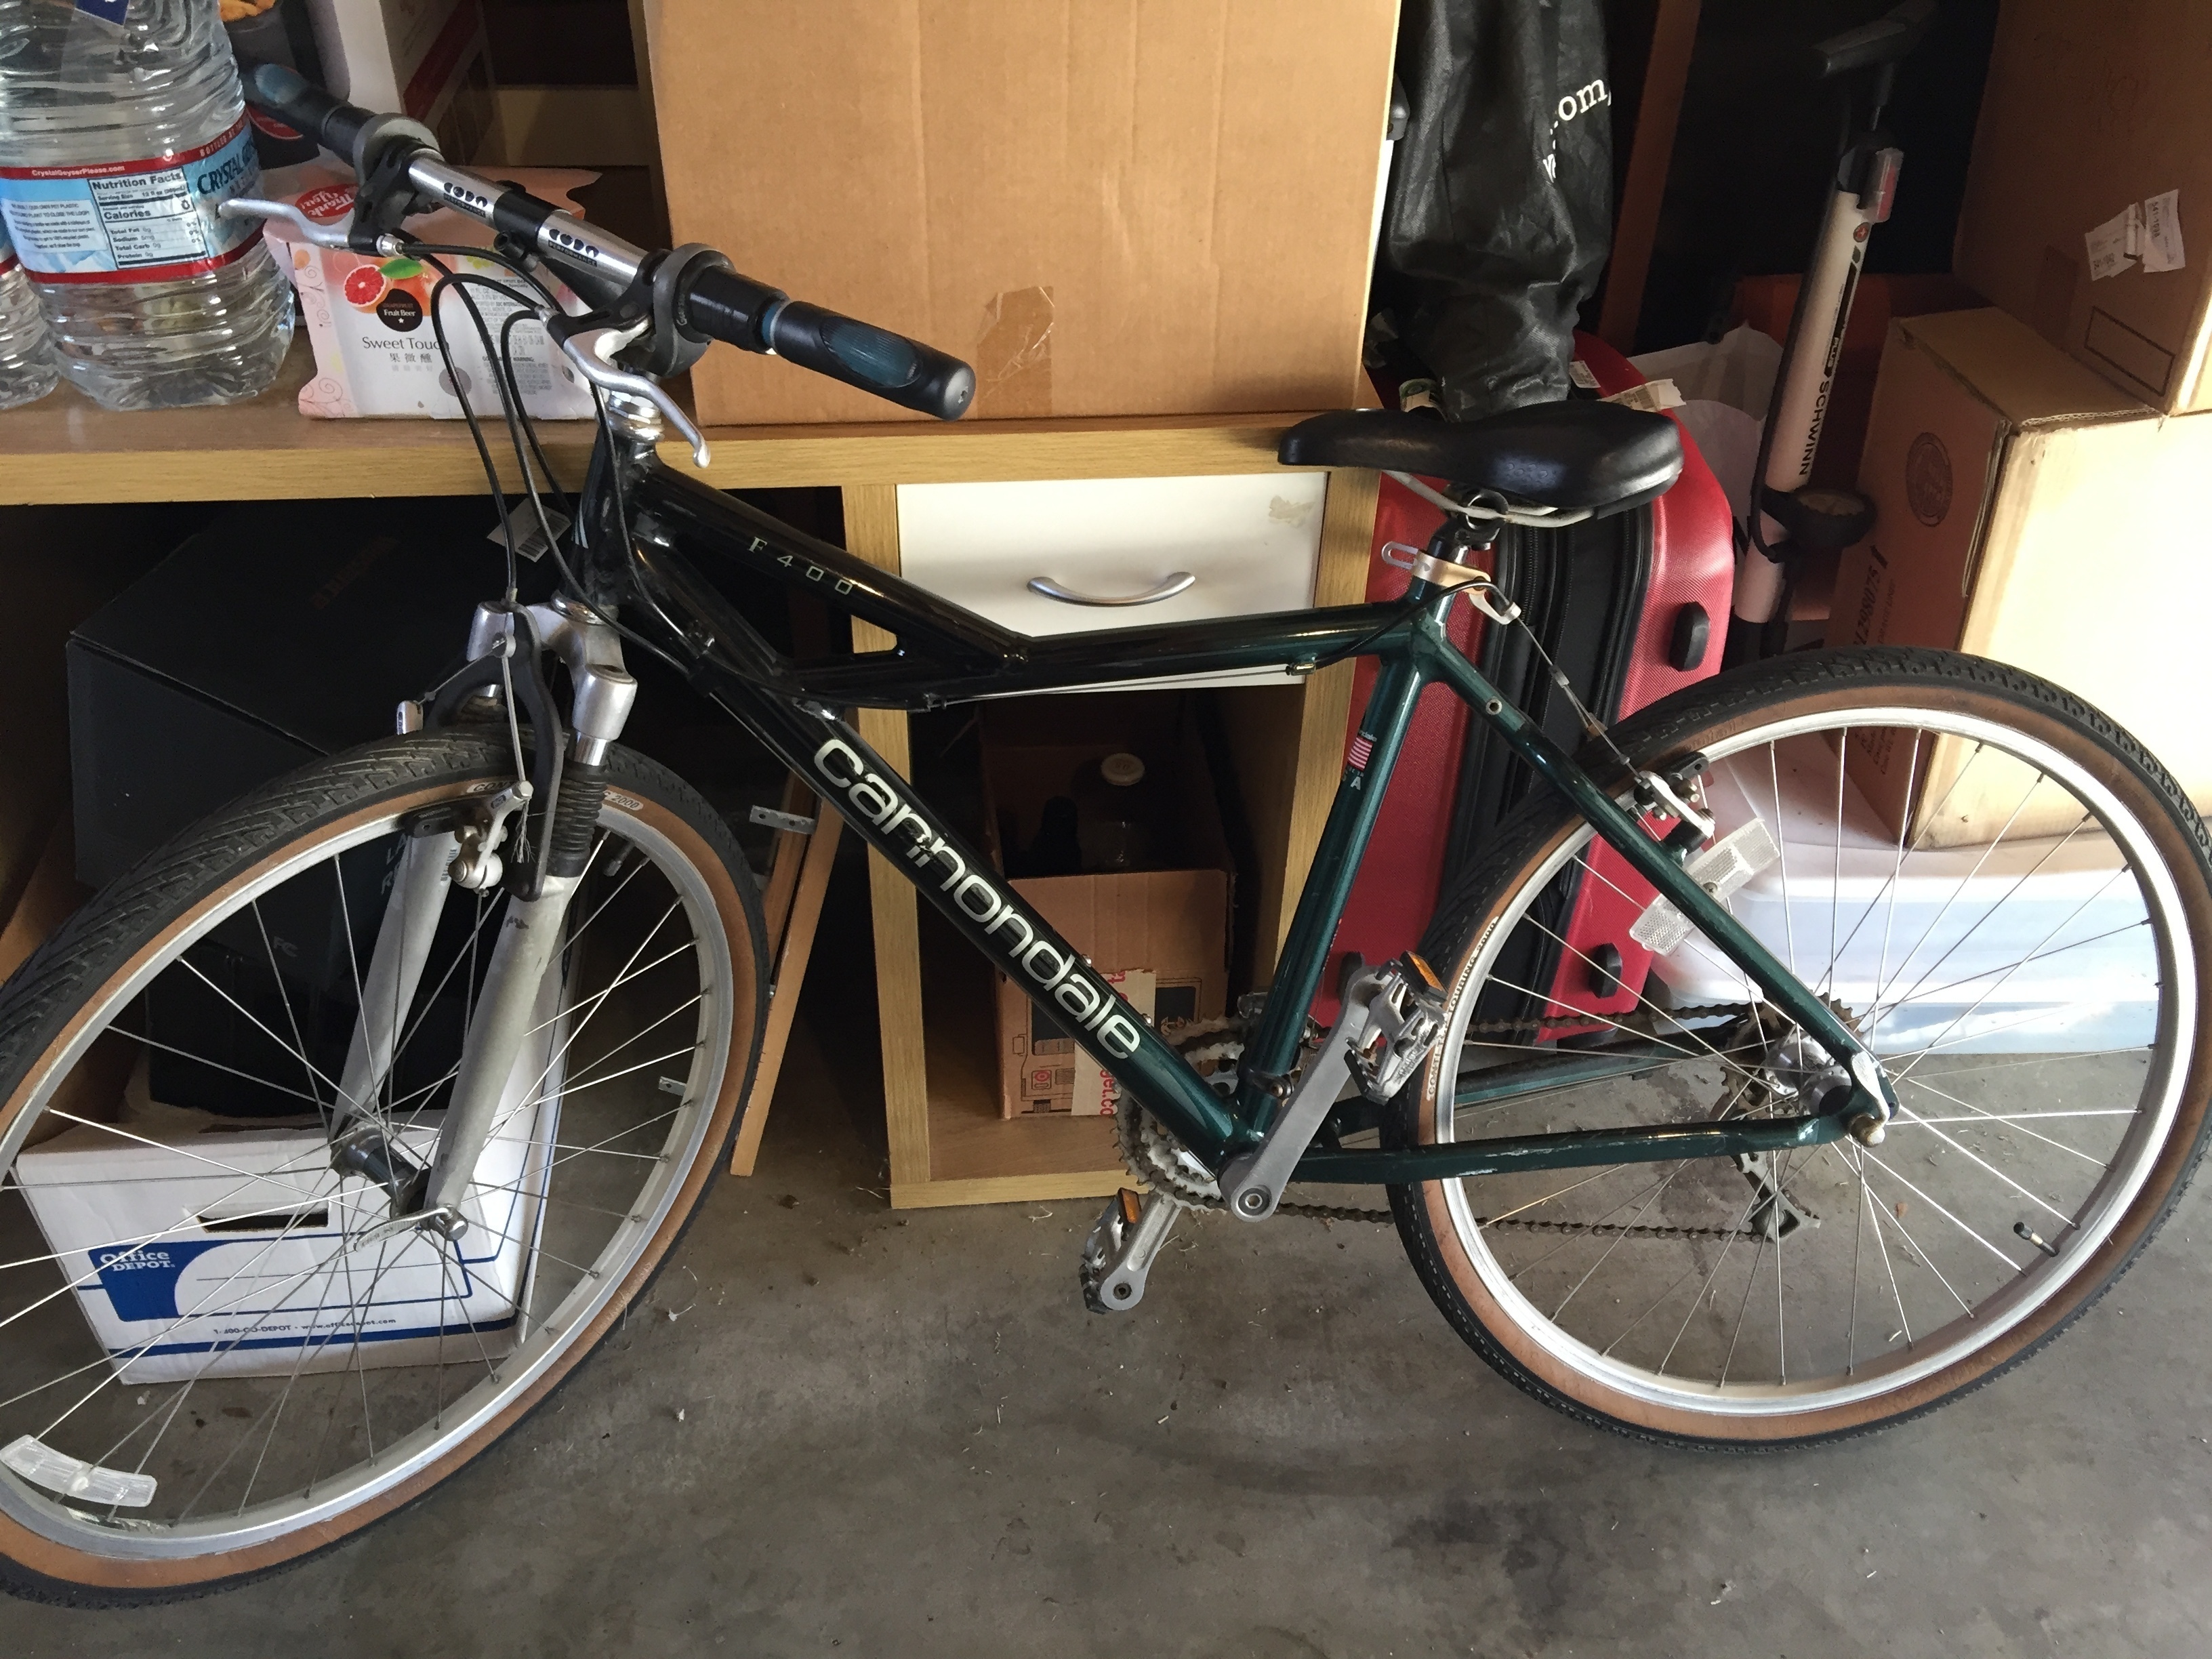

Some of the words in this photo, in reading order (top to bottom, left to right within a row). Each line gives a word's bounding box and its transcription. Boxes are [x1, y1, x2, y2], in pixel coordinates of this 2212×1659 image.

[32, 165, 125, 177] CrystalGeyserPlease.com
[92, 178, 146, 190] Nutrition
[150, 171, 182, 184] Facts
[197, 153, 244, 194] CRYSTAL
[181, 199, 190, 210] 0
[307, 192, 355, 216] Thank
[444, 182, 488, 208] CODA
[104, 210, 151, 220] Calories
[549, 229, 599, 258] CODA
[549, 241, 597, 266] PERFORMANCE
[362, 336, 405, 349] Sweet
[406, 337, 449, 350] Touc
[1799, 381, 1830, 476] SCHWINN
[611, 795, 639, 808] 2000
[814, 739, 1141, 1059] cannondale
[1429, 1053, 1441, 1095] CONTI
[1448, 956, 1477, 1014] TOURING
[1477, 922, 1496, 951] 2000
[100, 1250, 169, 1265] Office
